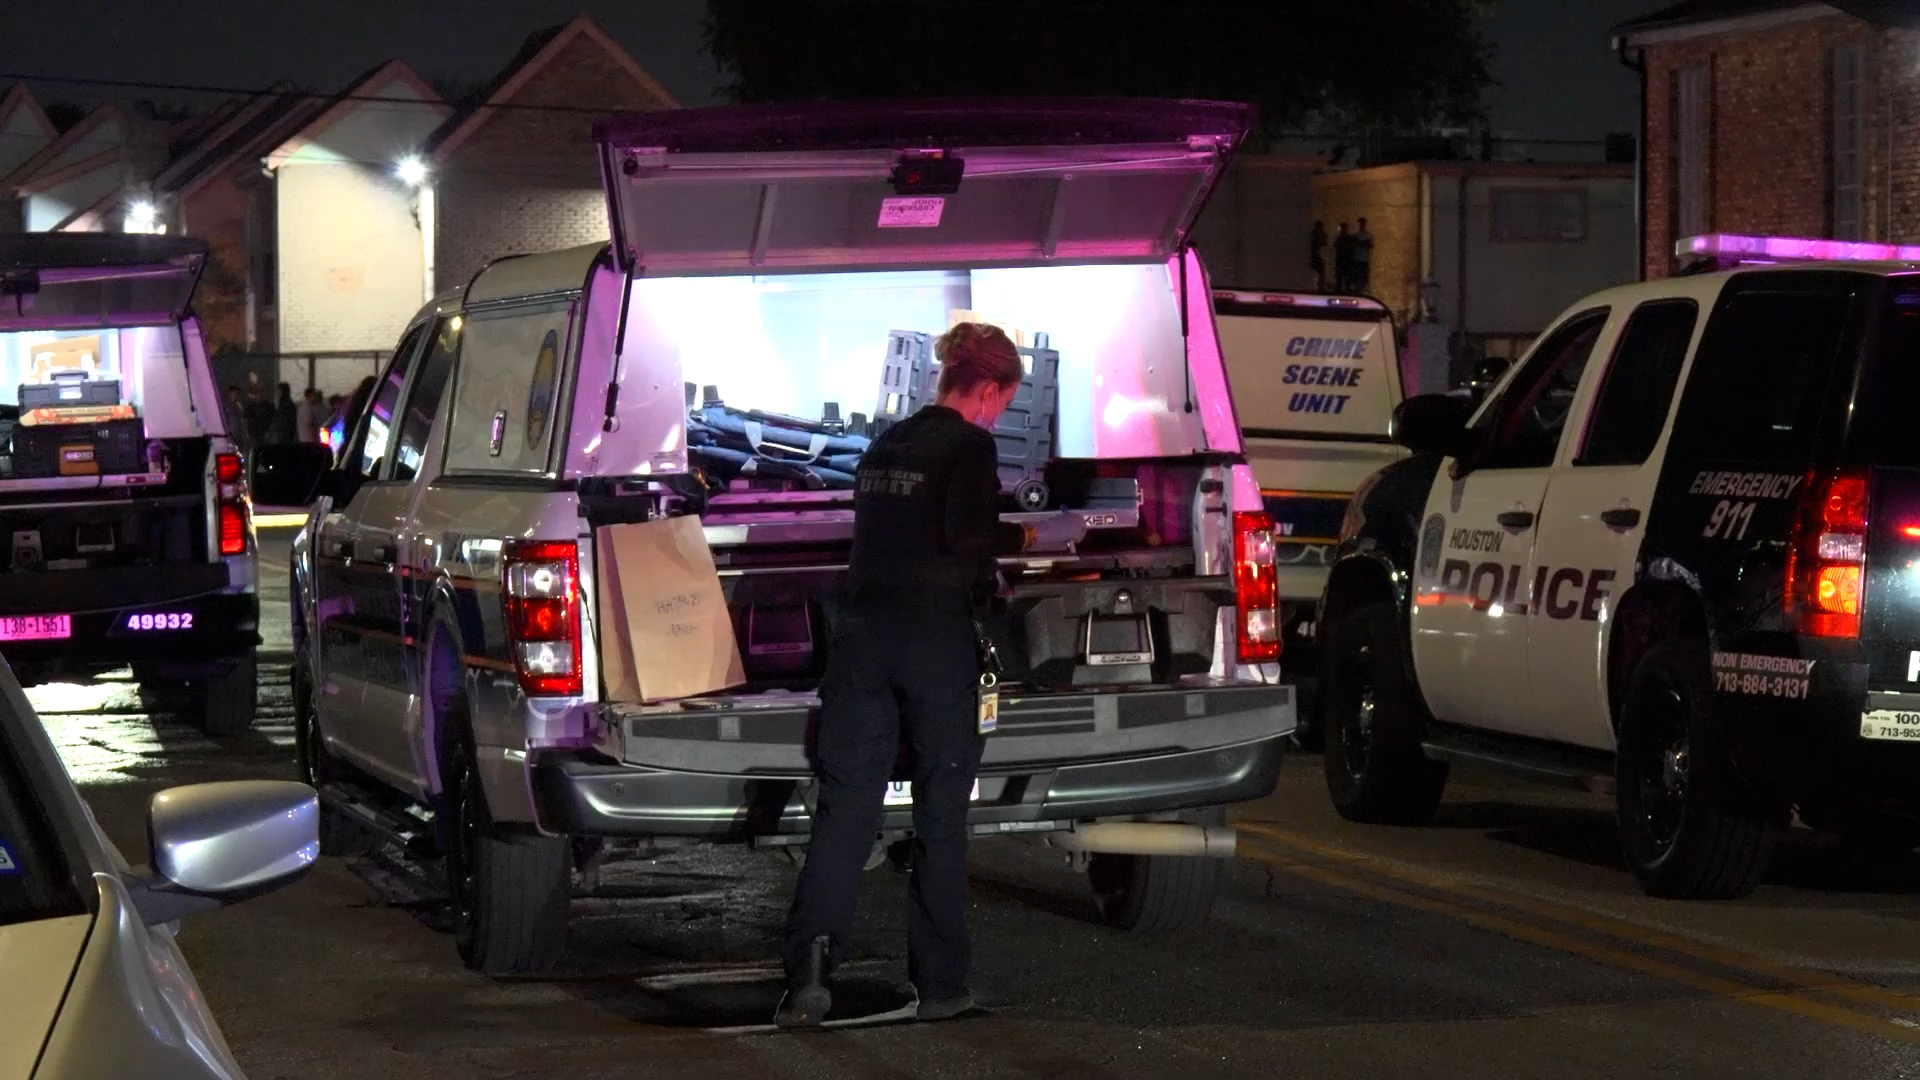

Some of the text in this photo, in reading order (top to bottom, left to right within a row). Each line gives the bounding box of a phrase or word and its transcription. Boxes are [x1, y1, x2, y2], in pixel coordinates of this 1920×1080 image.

[1285, 336, 1369, 359] CRIME
[1282, 364, 1364, 387] SCENE
[1288, 392, 1352, 415] UNIT
[860, 478, 917, 496] UNIT
[1688, 471, 1804, 499] EMERGENCY
[1702, 499, 1757, 541] 911
[1449, 528, 1504, 552] HOUSTON
[1441, 558, 1617, 622] POLICE
[2, 615, 67, 635] 138-1551
[127, 613, 193, 630] 49932
[1711, 651, 1817, 675] NON EMERGENCY
[1716, 671, 1809, 700] 713-884-3131
